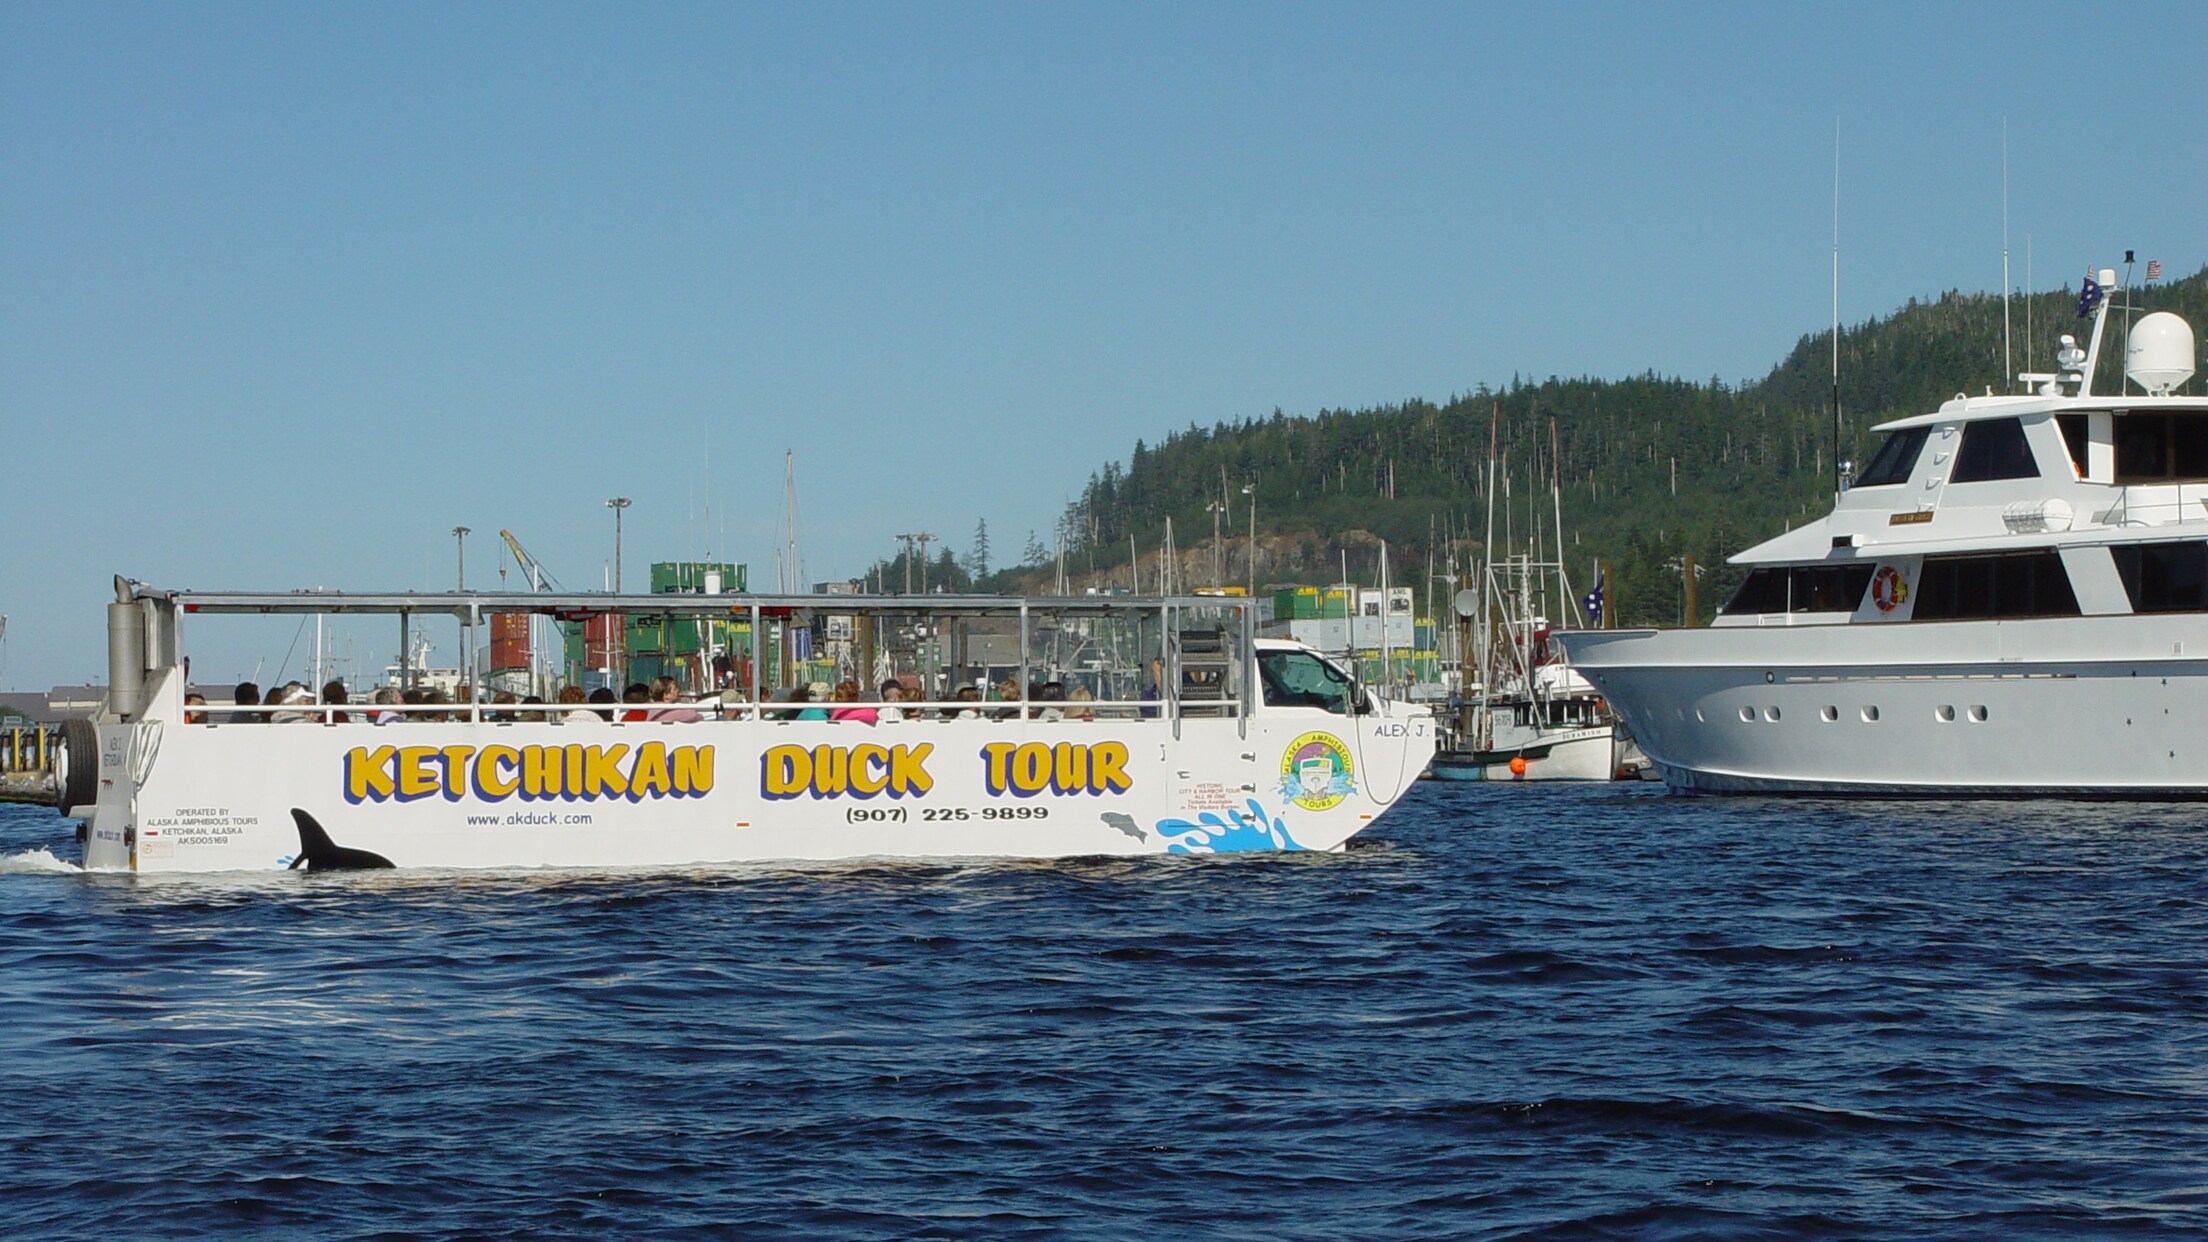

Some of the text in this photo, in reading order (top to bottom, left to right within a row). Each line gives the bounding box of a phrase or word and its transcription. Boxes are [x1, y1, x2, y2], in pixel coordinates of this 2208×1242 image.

[1374, 724, 1410, 737] ALEX
[1284, 741, 1302, 772] ALASKA
[342, 741, 1134, 804] KETCHIKAN DUCK TOUR
[1303, 799, 1333, 809] TOURS
[175, 808, 230, 816] OPERATED BY
[467, 811, 592, 826] www.akduck.com
[846, 806, 1050, 824] (907) 225-9899
[147, 817, 259, 826] ALASKA AMPHIBIOUS TOURS
[162, 827, 243, 837] KETCHIKAN, ALASKA
